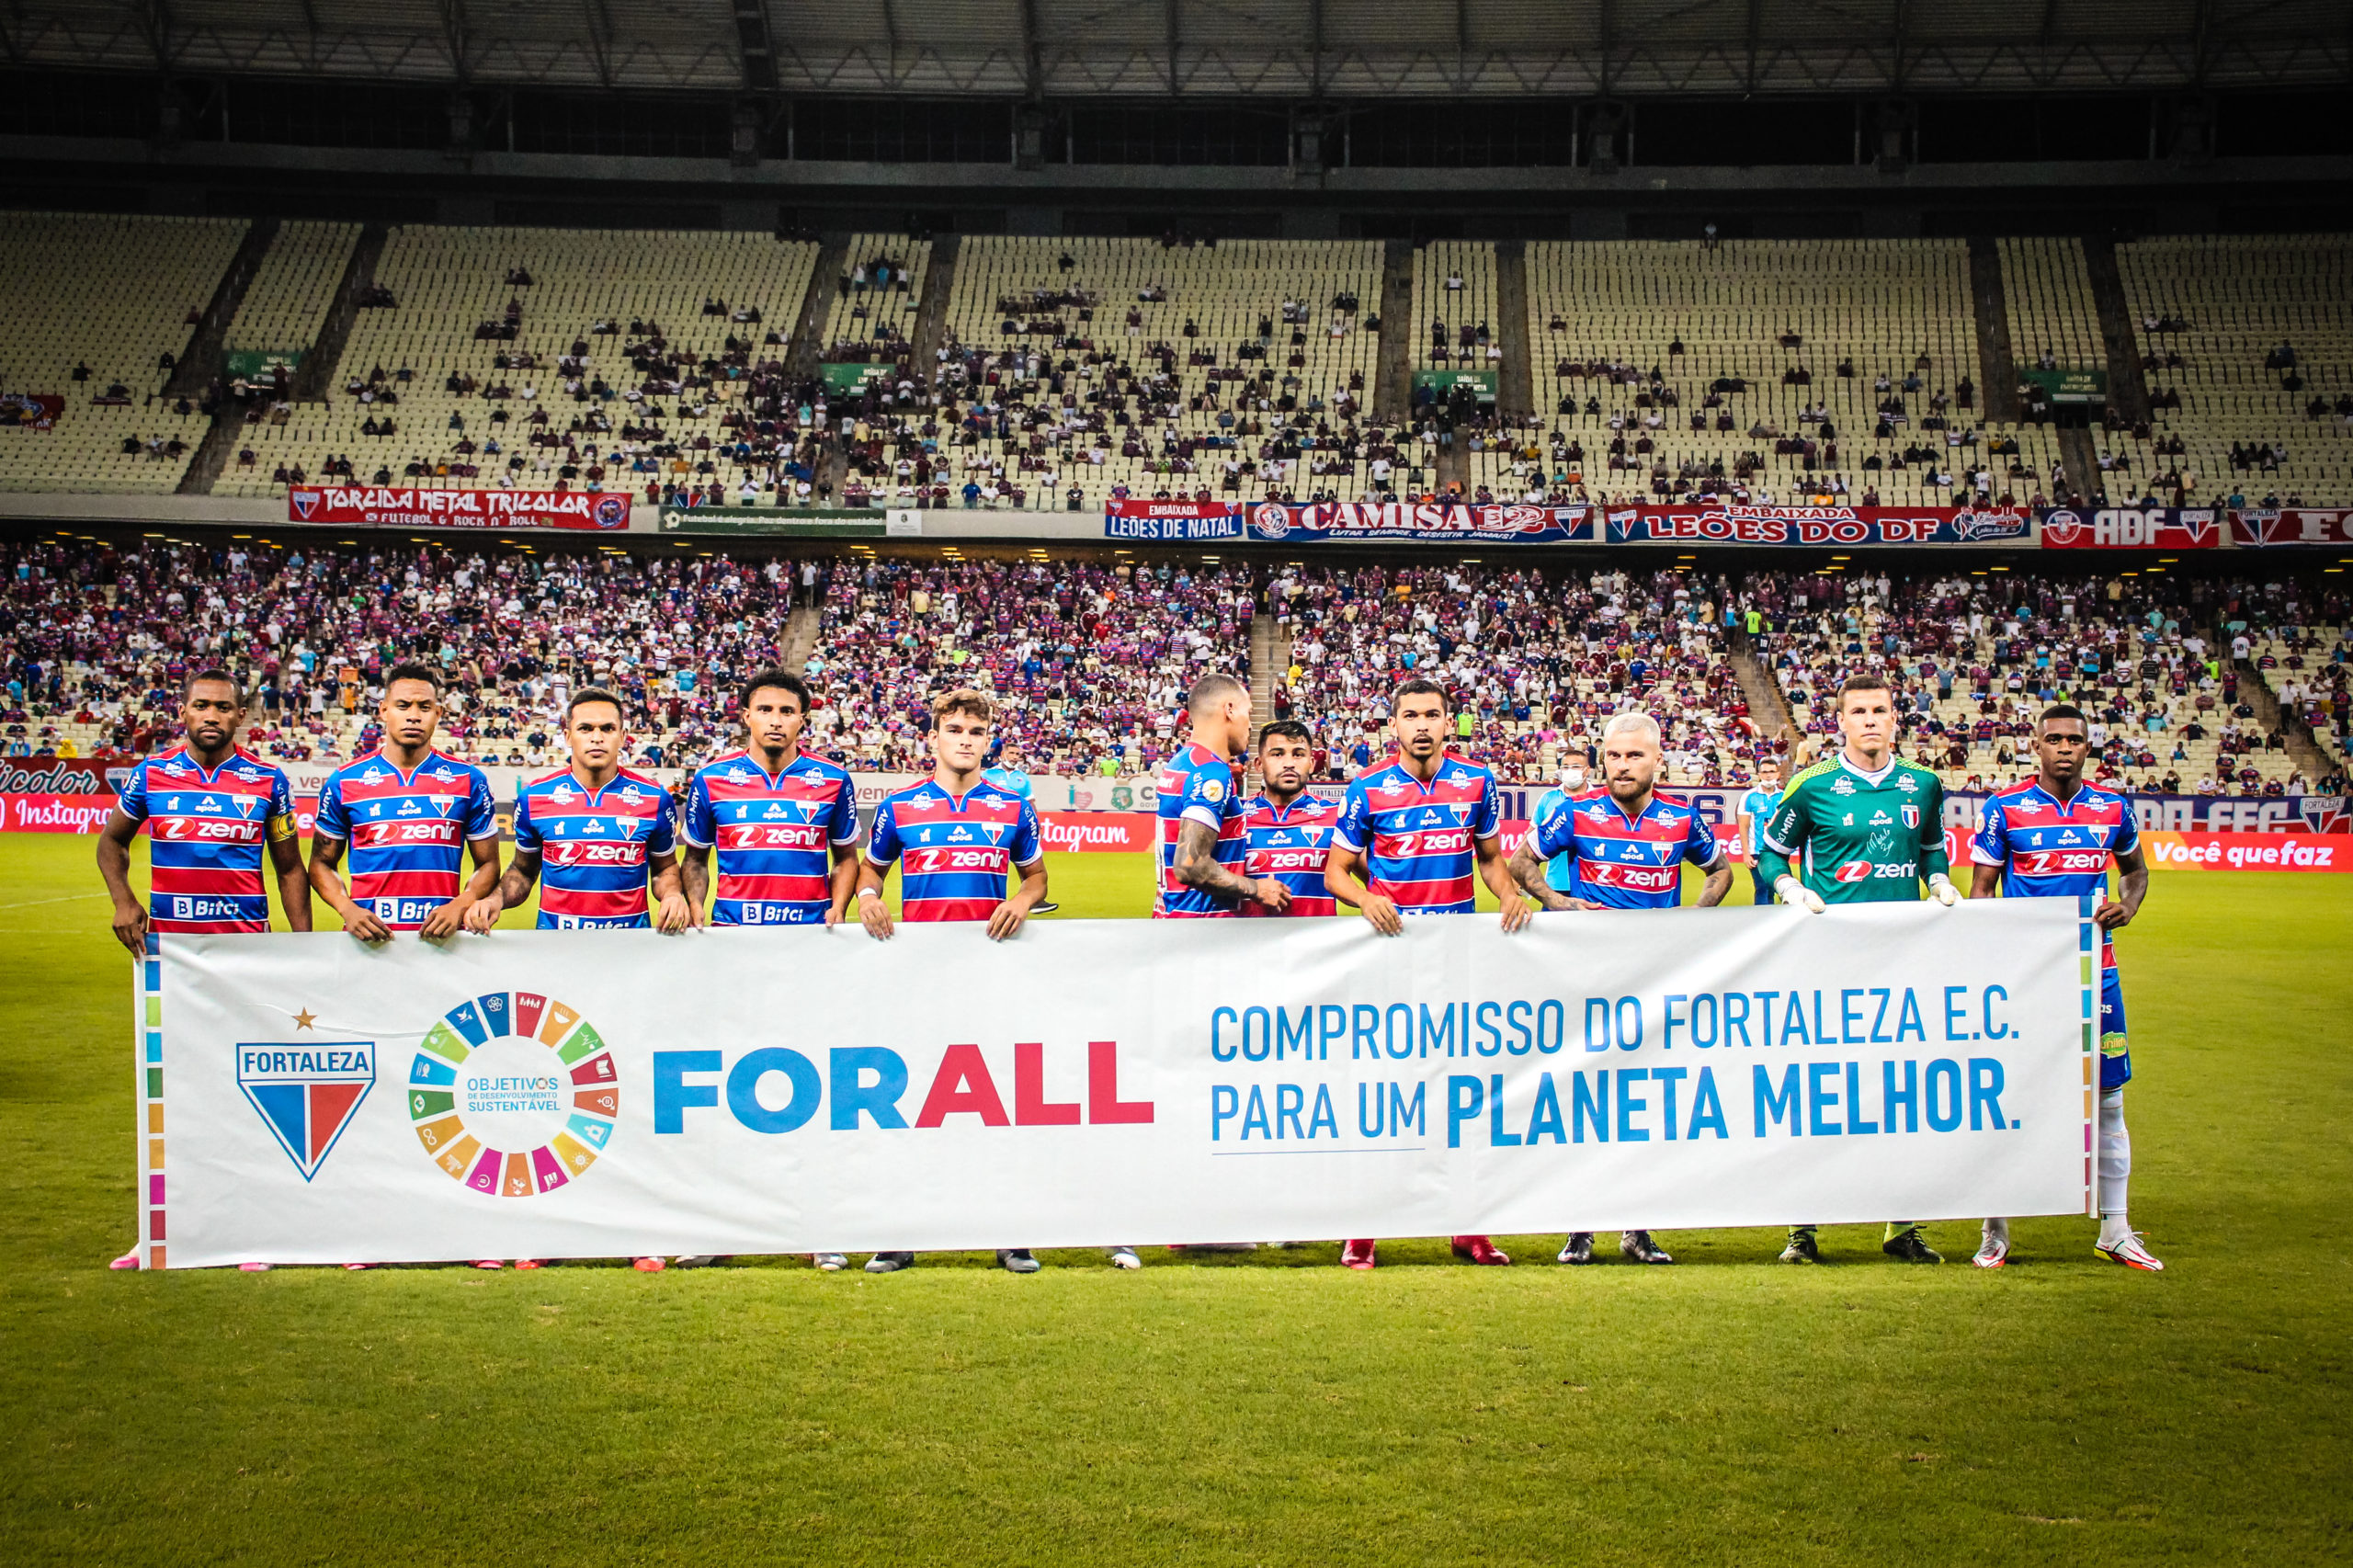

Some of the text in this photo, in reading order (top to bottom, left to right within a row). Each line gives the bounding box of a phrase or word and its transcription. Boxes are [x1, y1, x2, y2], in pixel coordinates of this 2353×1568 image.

[323, 488, 414, 512] TORCIDA
[419, 491, 482, 515] METAL
[486, 493, 591, 518] TRICOLOR
[1149, 505, 1199, 516] EMBAIXADA
[381, 513, 433, 525] FUTEBOL
[454, 515, 484, 527] ROCK
[509, 515, 538, 526] ROLL
[1301, 503, 1476, 531] CAMISA
[1727, 506, 1856, 520] EMBAIXADA
[2240, 509, 2280, 518] FORTALEZA
[1110, 515, 1158, 538] LEÕES
[1164, 519, 1185, 538] DE
[1188, 517, 1236, 538] NATAL
[1329, 528, 1364, 537] LUTAR
[1468, 531, 1517, 540] JAMAIS!
[1644, 511, 1940, 544] LEÕES DO DF
[2094, 509, 2165, 545] ADF
[0, 761, 99, 795] icolor
[689, 787, 699, 812] MRV
[1348, 796, 1362, 820] MRV
[2304, 800, 2340, 809] FORTALEZA
[16, 799, 113, 835] Instagra
[397, 808, 422, 816] apodi
[1420, 816, 1442, 826] apodi
[1869, 816, 1893, 827] apodi
[198, 822, 259, 840] zenir
[401, 821, 455, 840] zenir
[877, 809, 889, 835] MRV
[1549, 812, 1568, 835] MRV
[1781, 809, 1797, 835] MRV
[1989, 810, 2000, 836] MRV
[766, 827, 820, 846] zenir
[1040, 818, 1130, 853] tagram
[1424, 830, 1471, 851] zenir
[2058, 837, 2081, 846] apodi
[585, 844, 641, 861] zenir
[950, 849, 1004, 868] zenir
[1270, 850, 1326, 869] zenir
[1620, 852, 1644, 861] apodi
[2153, 841, 2334, 868] Você que faz
[1624, 868, 1673, 887] zenir
[1874, 858, 1917, 879] zenir
[195, 900, 240, 916] Bitci
[401, 902, 439, 920] Bit
[764, 906, 803, 922] Bitci
[1211, 984, 2019, 1062] COMPROMISSO DO FORTALEZA E.C.
[244, 1051, 369, 1073] FORTALEZA
[467, 1077, 559, 1091] OBJETIVOS
[467, 1092, 558, 1100] DE DESENVOLVIMENTO
[468, 1099, 561, 1112] SUSTENTÁVEL
[1211, 1057, 2021, 1149] PARA UM PLANETA MELHOR.
